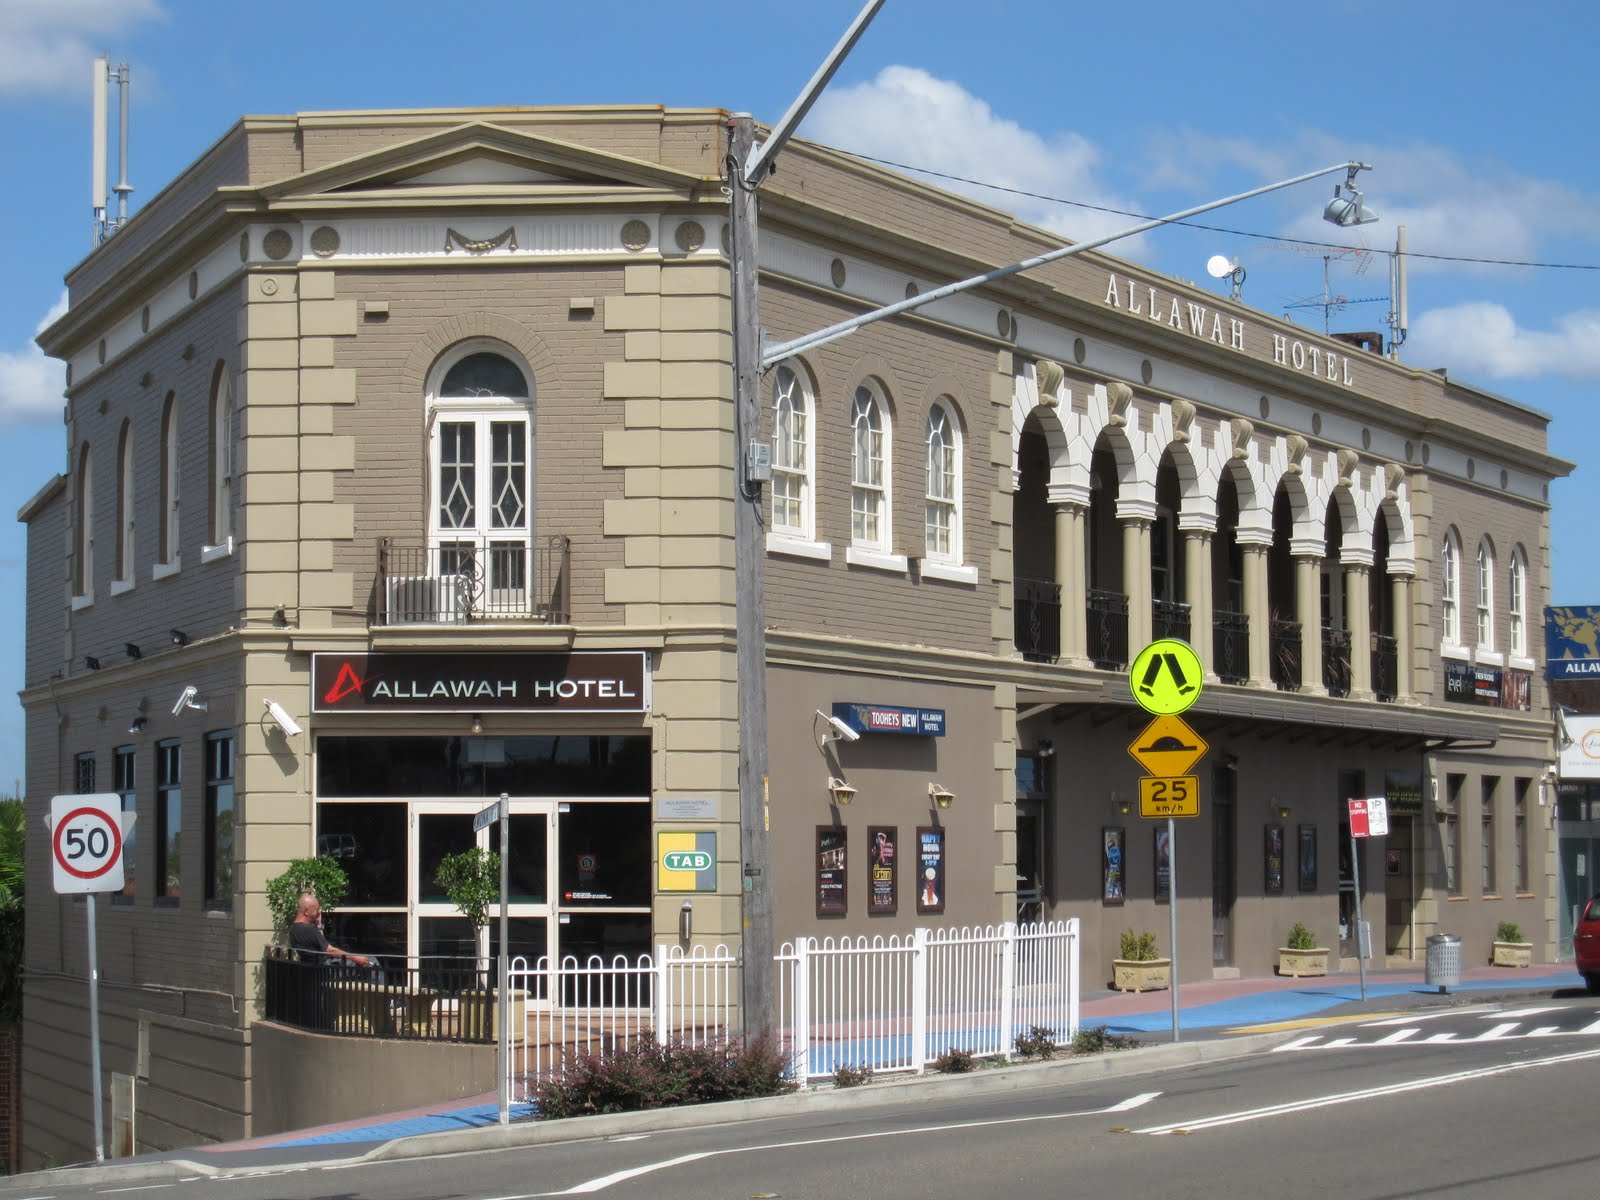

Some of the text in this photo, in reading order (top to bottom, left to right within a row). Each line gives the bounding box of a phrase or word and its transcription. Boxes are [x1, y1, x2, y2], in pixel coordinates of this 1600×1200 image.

[1104, 273, 1353, 387] ALLAWAH HOTEL
[371, 679, 636, 698] ALLAWAH HOTEL
[871, 712, 917, 728] TOOHEYS NEW
[921, 713, 943, 722] ALLAWAH
[924, 723, 939, 731] HOTEL
[1151, 781, 1188, 802] 25
[1155, 804, 1183, 814] km/h
[66, 827, 109, 860] 50
[670, 855, 705, 867] TAB
